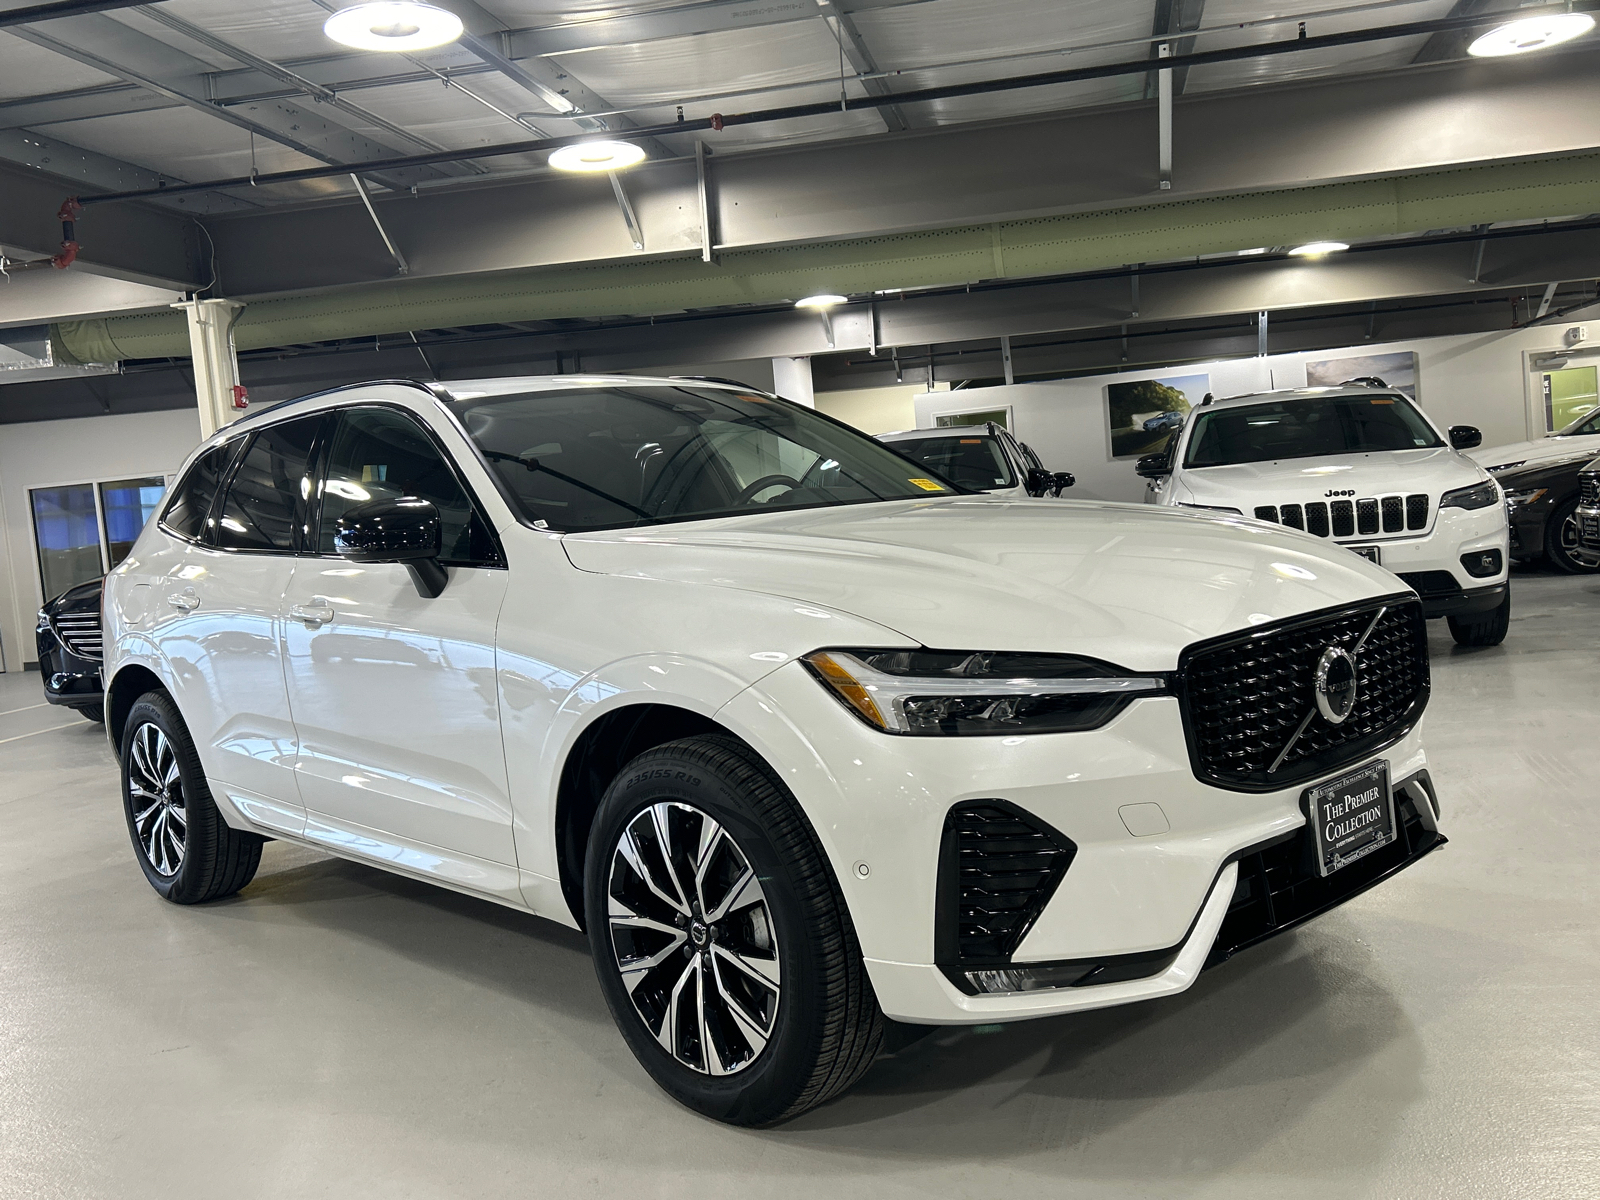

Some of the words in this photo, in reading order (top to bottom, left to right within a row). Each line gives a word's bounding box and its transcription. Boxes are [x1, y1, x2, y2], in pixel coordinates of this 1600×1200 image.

[1324, 489, 1356, 498] Jeep
[626, 769, 673, 790] 235/55
[675, 771, 702, 787] R19
[1323, 802, 1345, 822] THE
[1344, 786, 1380, 814] PREMIER
[1325, 805, 1381, 841] COLLECTION
